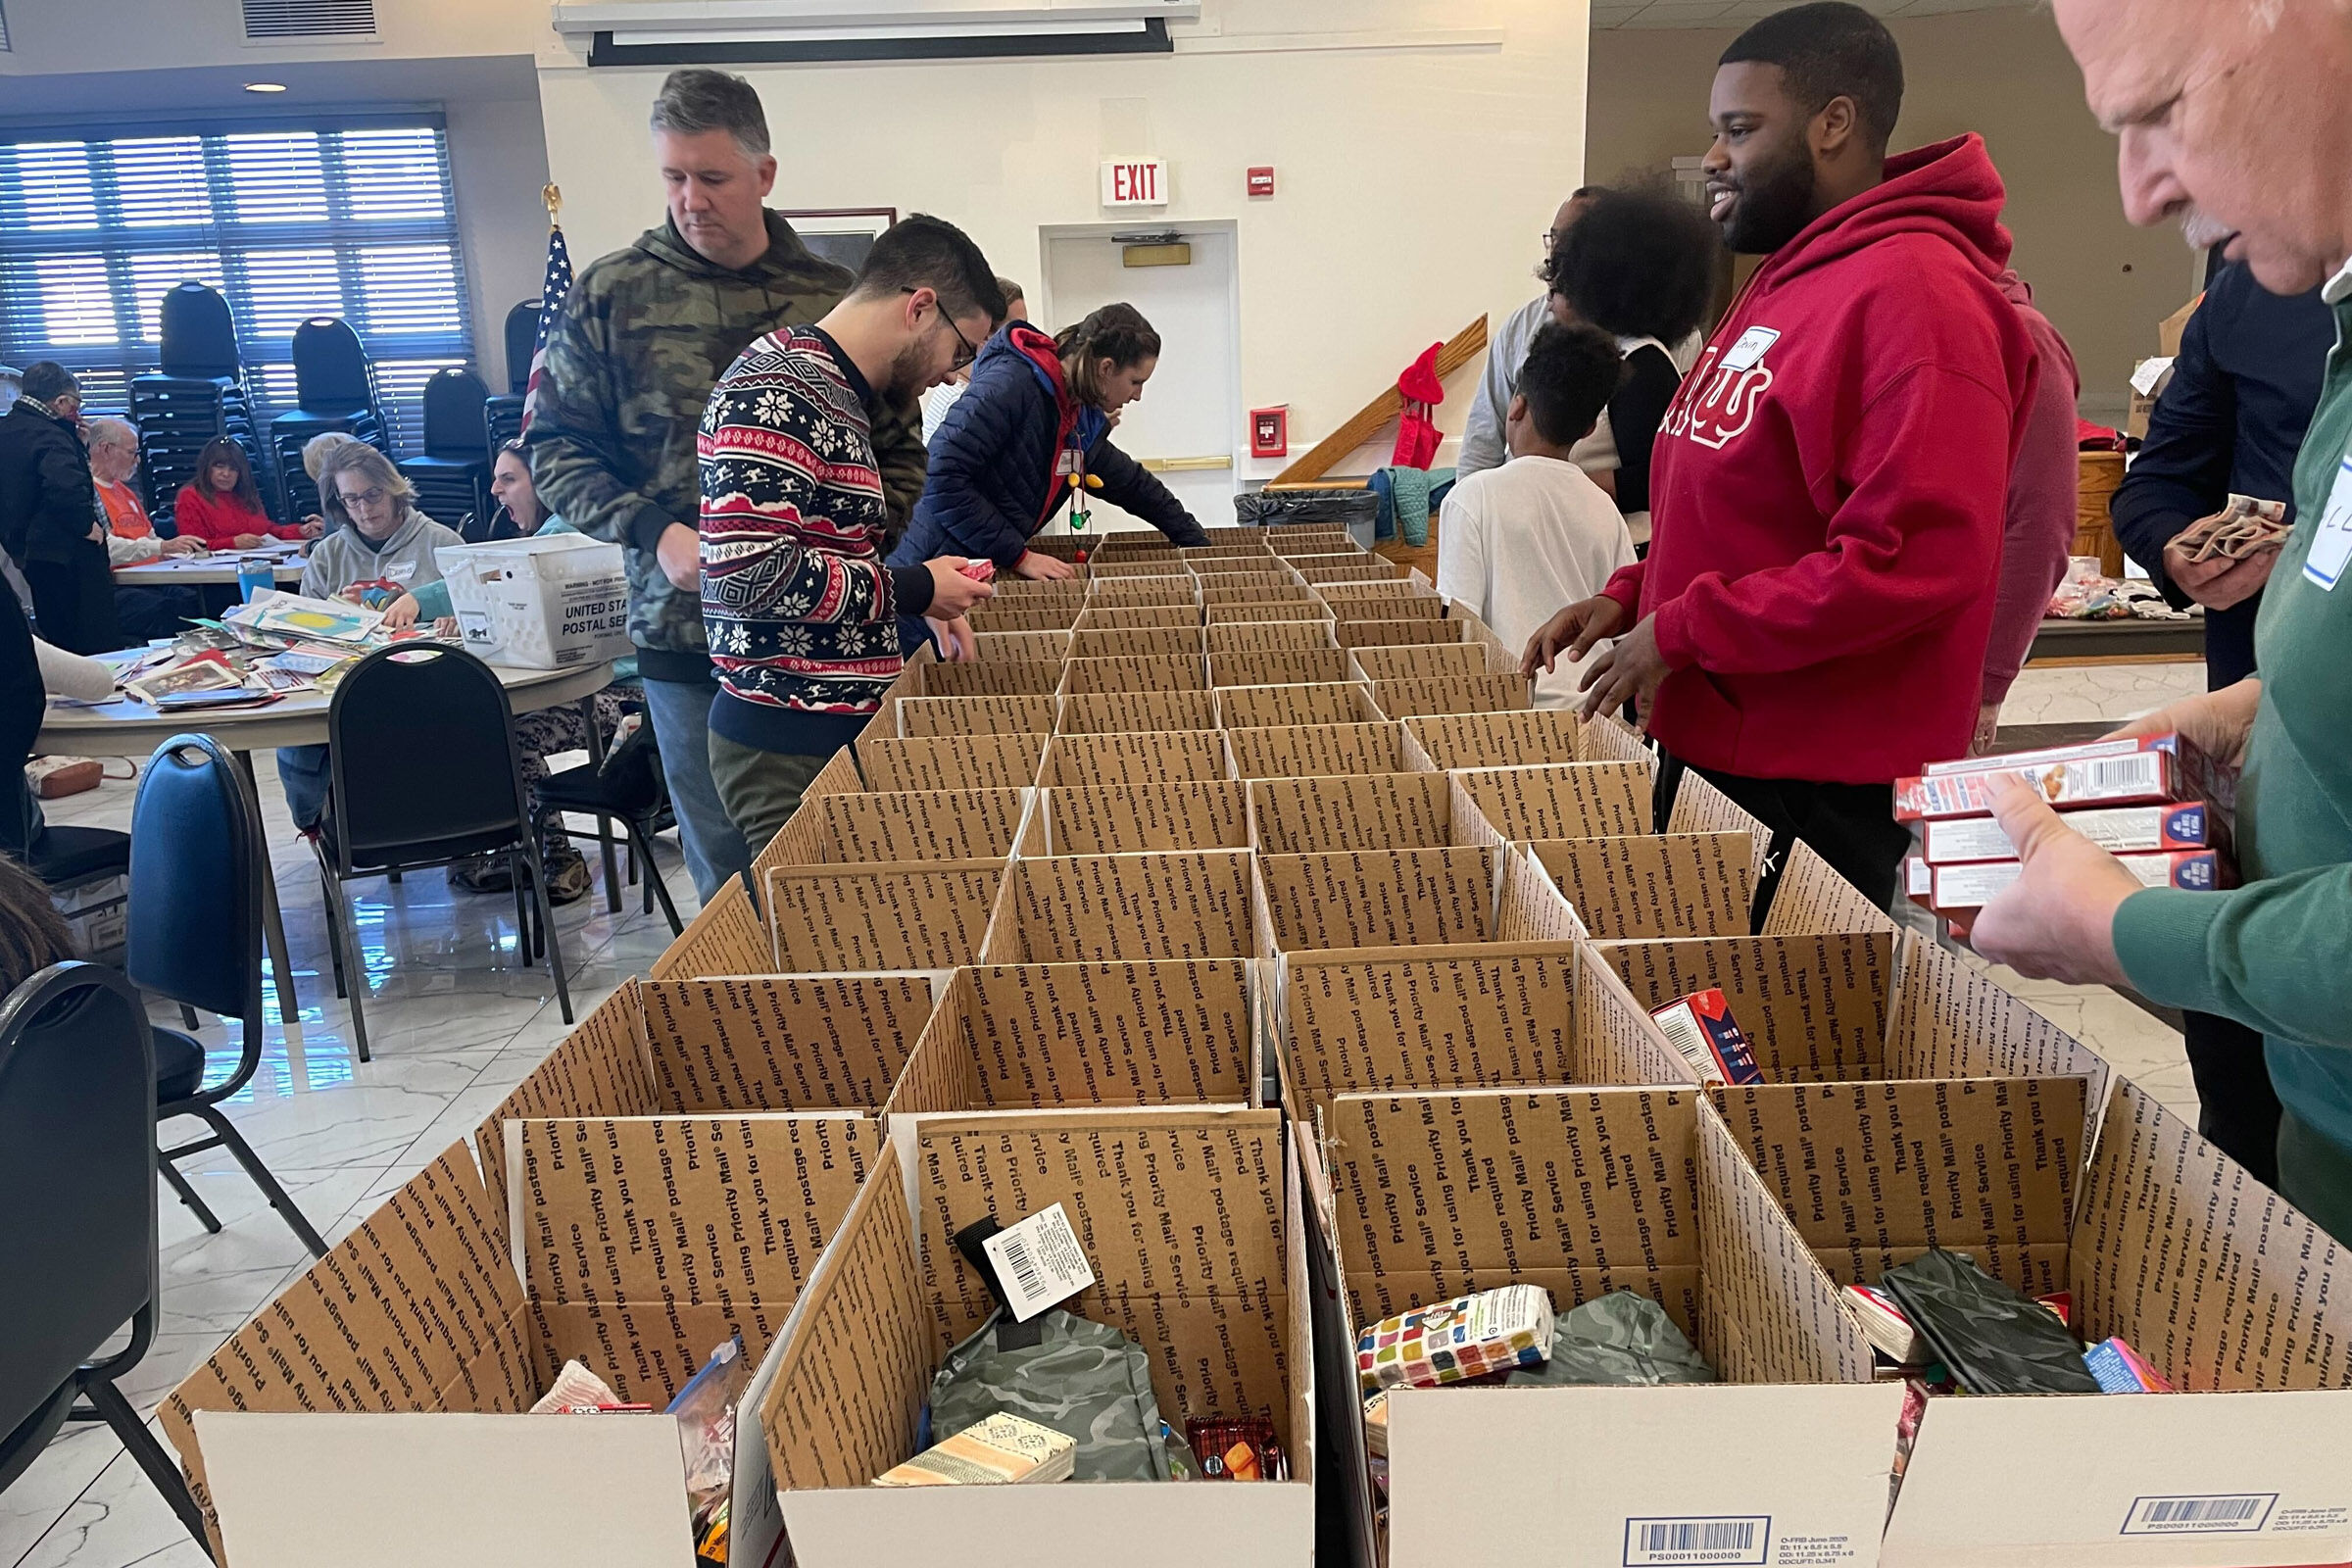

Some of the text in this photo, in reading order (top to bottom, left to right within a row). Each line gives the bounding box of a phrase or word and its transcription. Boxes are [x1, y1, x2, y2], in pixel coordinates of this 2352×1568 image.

[1114, 165, 1157, 201] EXIT
[565, 602, 606, 619] UNITED
[562, 618, 607, 636] POSTAL
